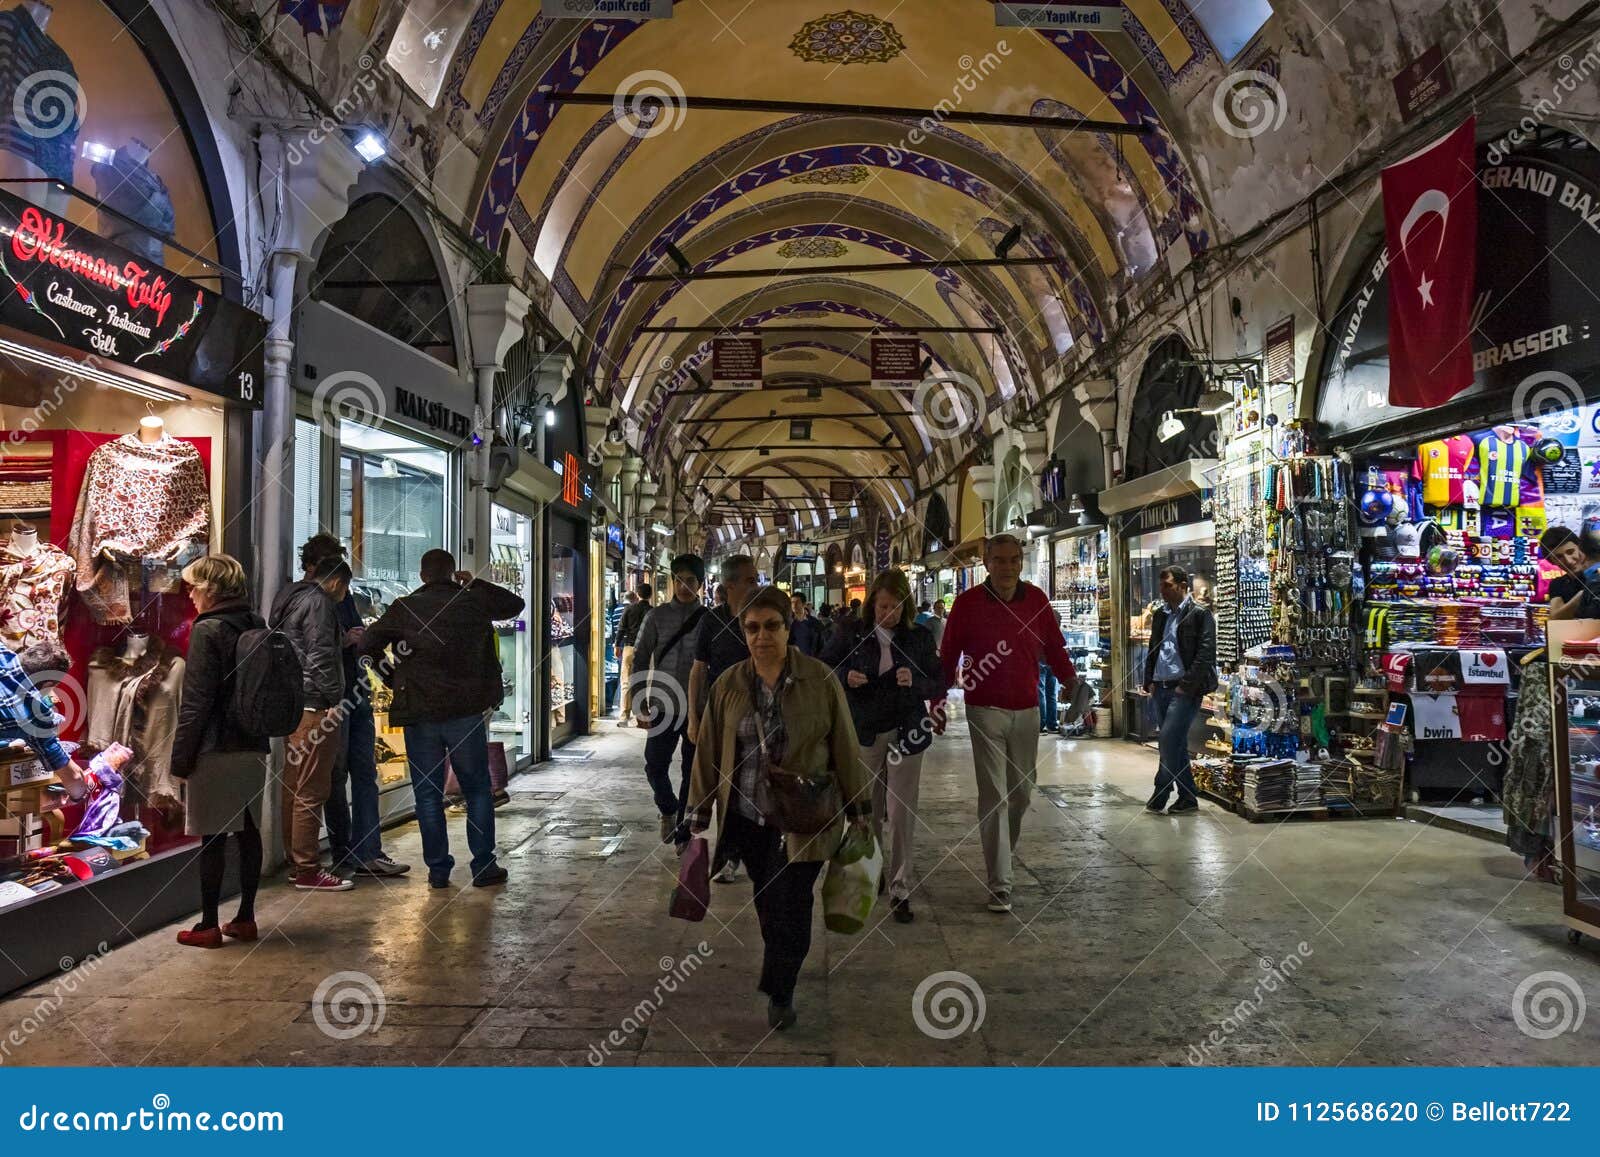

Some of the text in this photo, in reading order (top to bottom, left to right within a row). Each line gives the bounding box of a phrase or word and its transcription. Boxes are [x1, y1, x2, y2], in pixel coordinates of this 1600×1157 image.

[1483, 167, 1557, 197] GRAND
[123, 261, 172, 327] Tulip
[82, 329, 119, 355] Silk
[238, 371, 253, 400] 13
[1472, 652, 1481, 666] I
[1424, 725, 1453, 738] bwin
